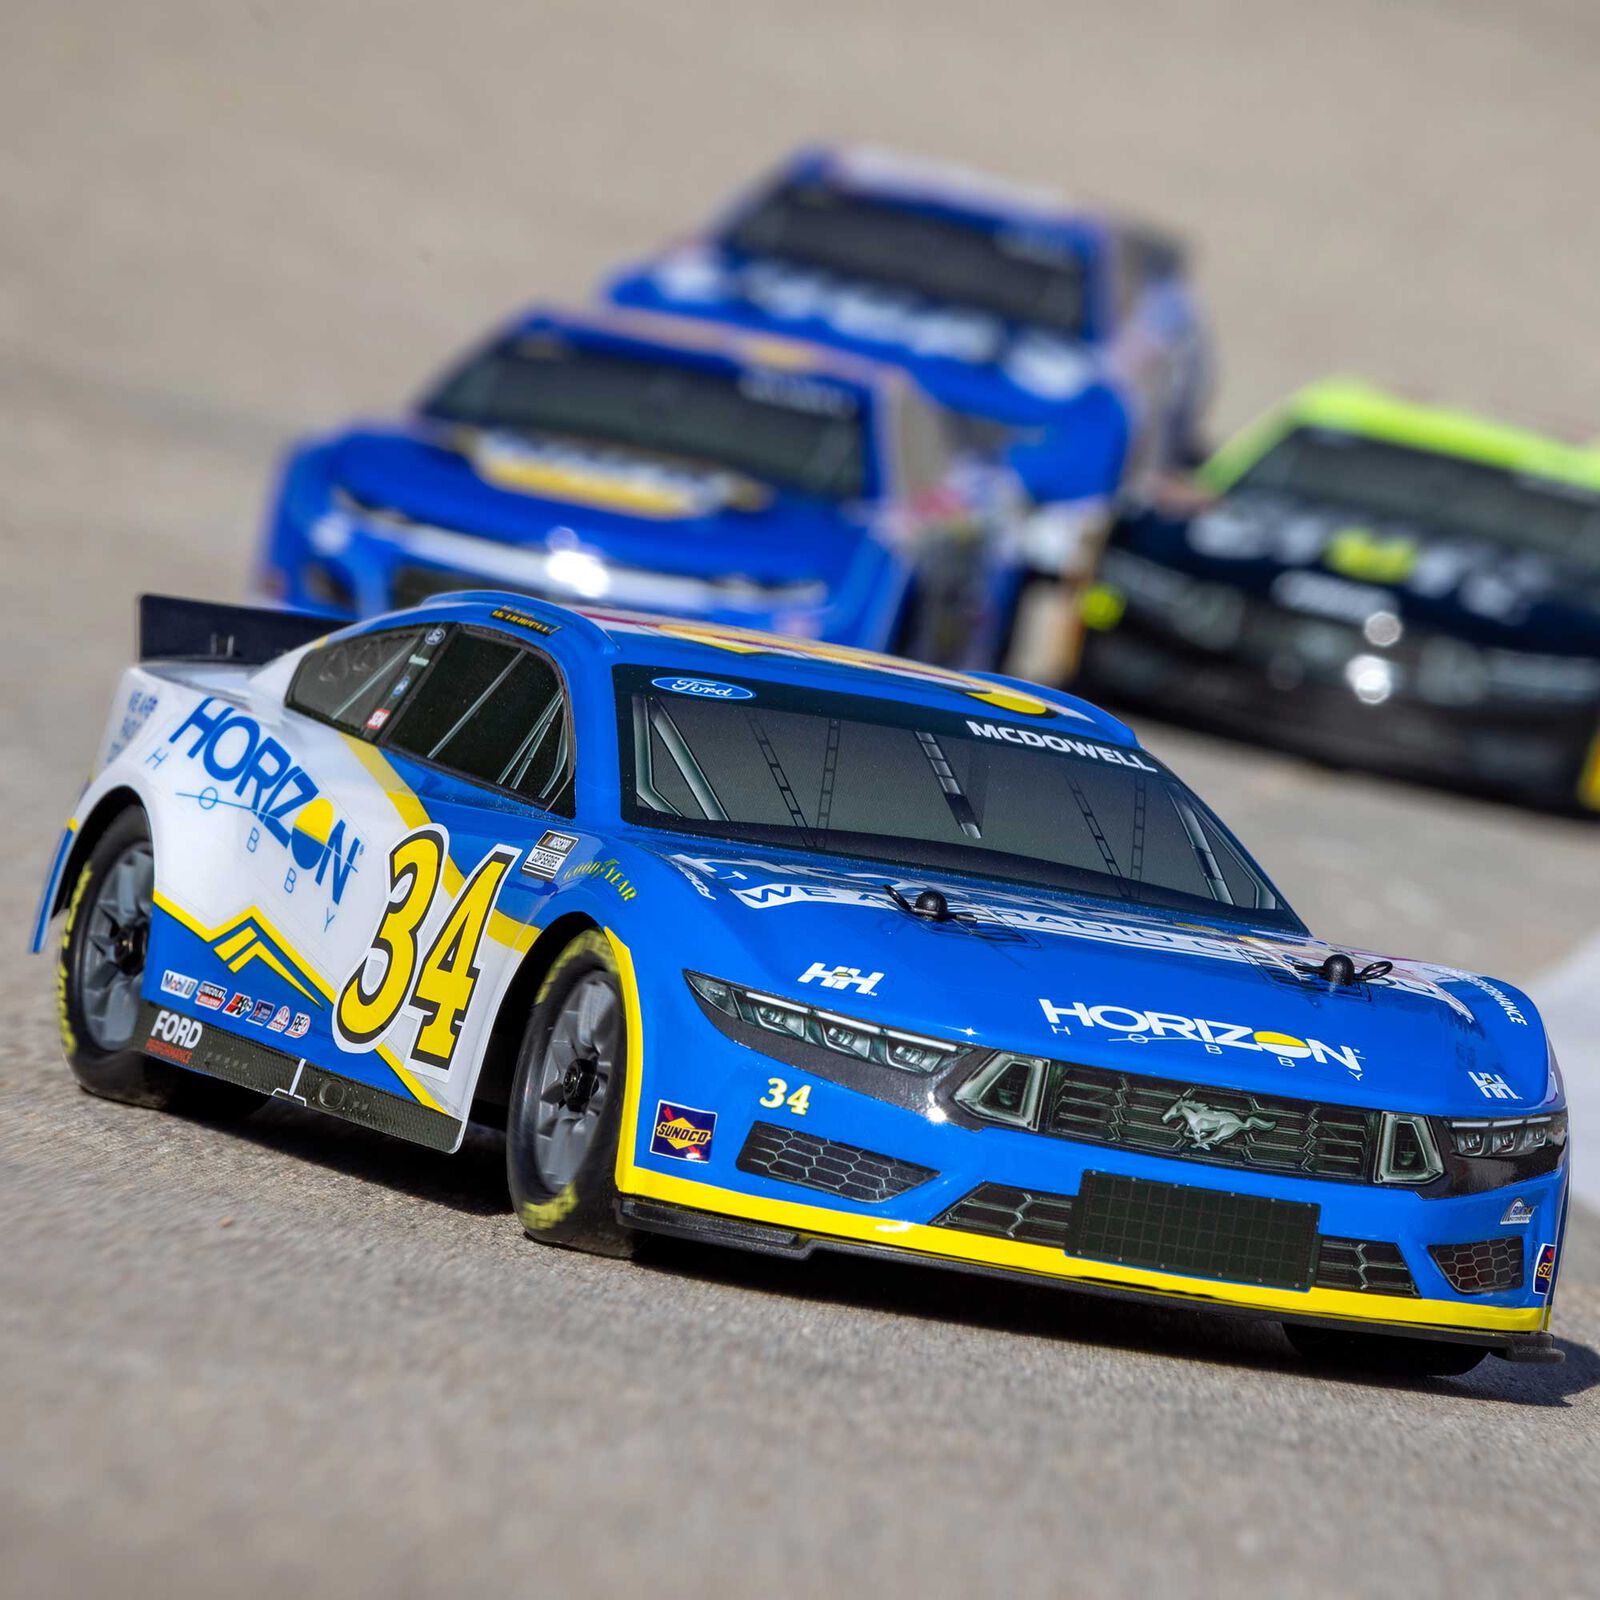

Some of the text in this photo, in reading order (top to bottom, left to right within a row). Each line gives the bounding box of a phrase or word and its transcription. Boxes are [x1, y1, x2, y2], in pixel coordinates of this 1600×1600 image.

[671, 680, 733, 697] Ford
[965, 720, 1158, 773] MCDOWELL
[168, 696, 361, 905] HORIZON
[333, 824, 521, 1080] 34
[150, 1009, 203, 1049] FORD
[1038, 998, 1363, 1072] HORIZON
[759, 1077, 813, 1116] 34
[658, 1123, 710, 1144] SUNOCO
